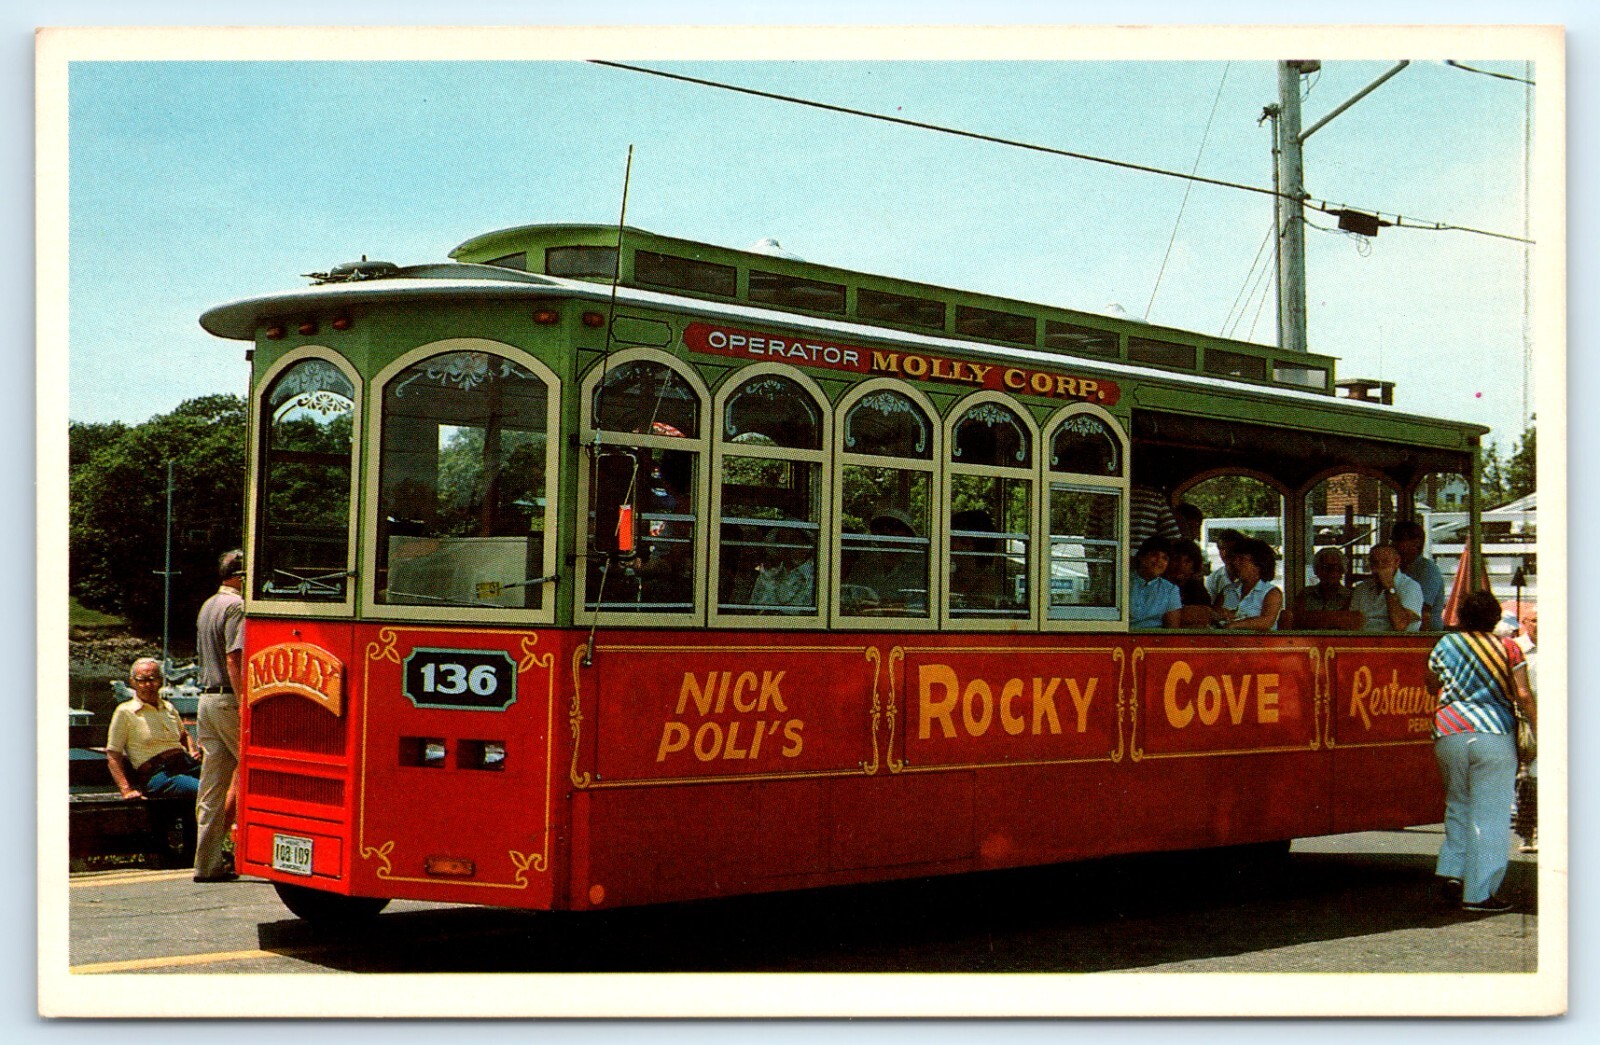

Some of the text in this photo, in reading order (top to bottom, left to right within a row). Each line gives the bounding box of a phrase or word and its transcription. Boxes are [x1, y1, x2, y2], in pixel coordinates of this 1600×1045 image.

[708, 331, 1106, 400] OPERATOR MOLLY CORP.
[249, 648, 340, 698] MOLLY
[420, 662, 498, 696] 136
[675, 670, 789, 716] NICK
[656, 718, 805, 762] POLI'S
